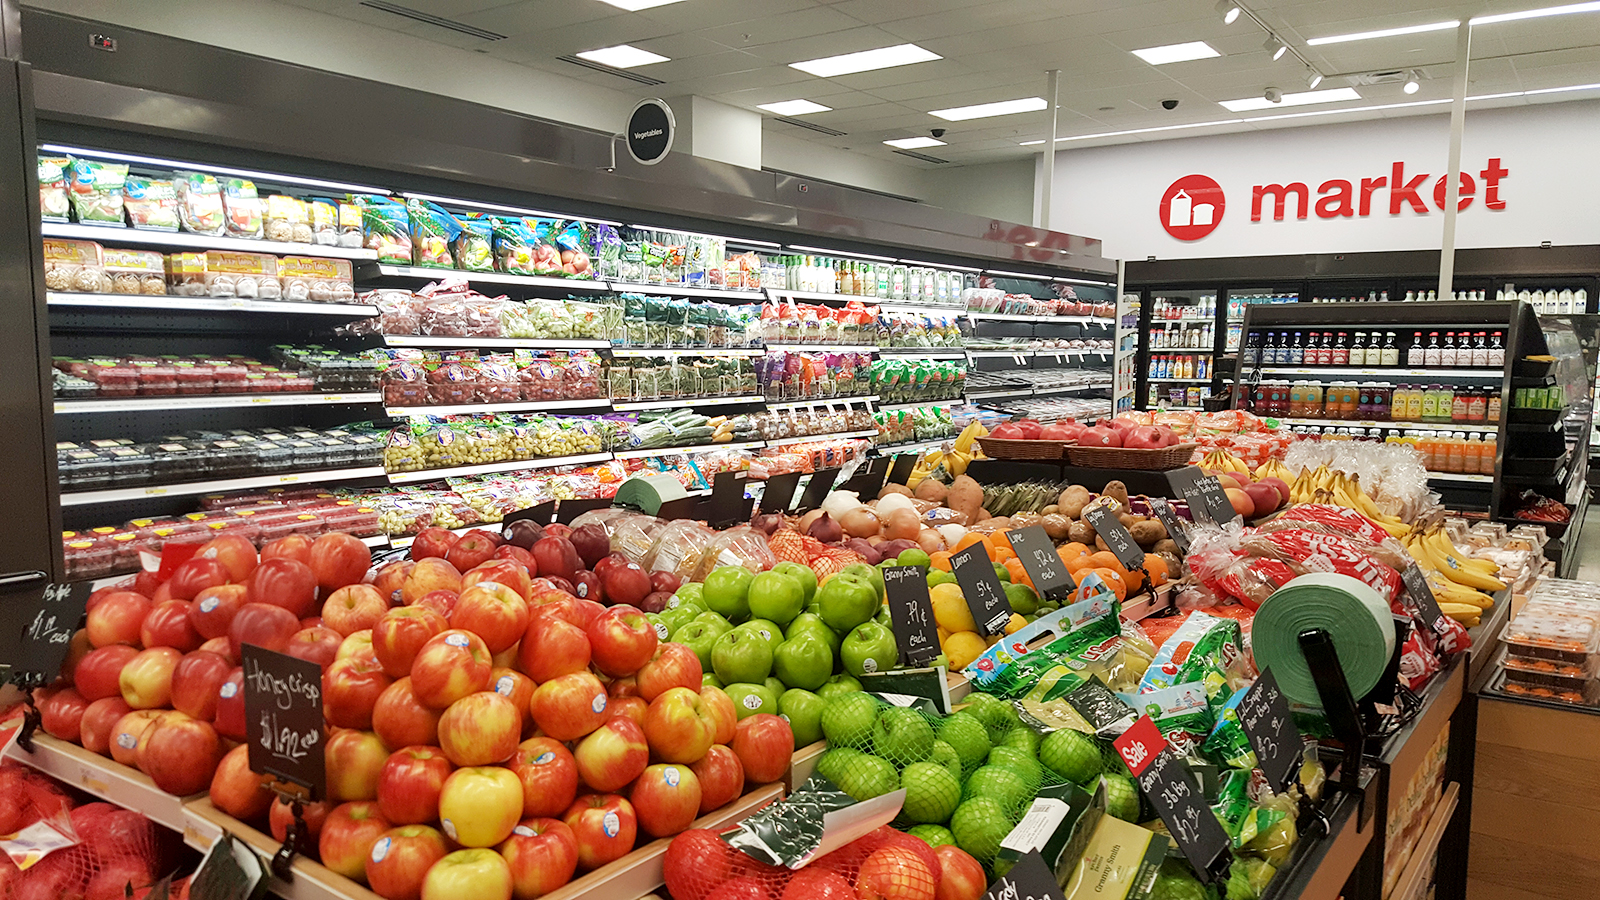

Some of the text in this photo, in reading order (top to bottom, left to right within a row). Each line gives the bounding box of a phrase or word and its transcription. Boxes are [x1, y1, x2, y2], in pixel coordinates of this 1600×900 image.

[634, 129, 663, 140] Vegetables
[1250, 158, 1509, 222] market
[951, 552, 972, 570] Lemon
[884, 566, 920, 584] Granny Smith
[1041, 568, 1056, 580] each
[985, 592, 999, 611] each
[49, 629, 71, 644] each
[909, 629, 927, 647] each
[1256, 701, 1271, 718] Bag
[1122, 739, 1149, 768] Sale
[1140, 750, 1173, 793] Granny Smith
[1170, 781, 1191, 797] Bag
[1094, 844, 1121, 893] Granny Smith
